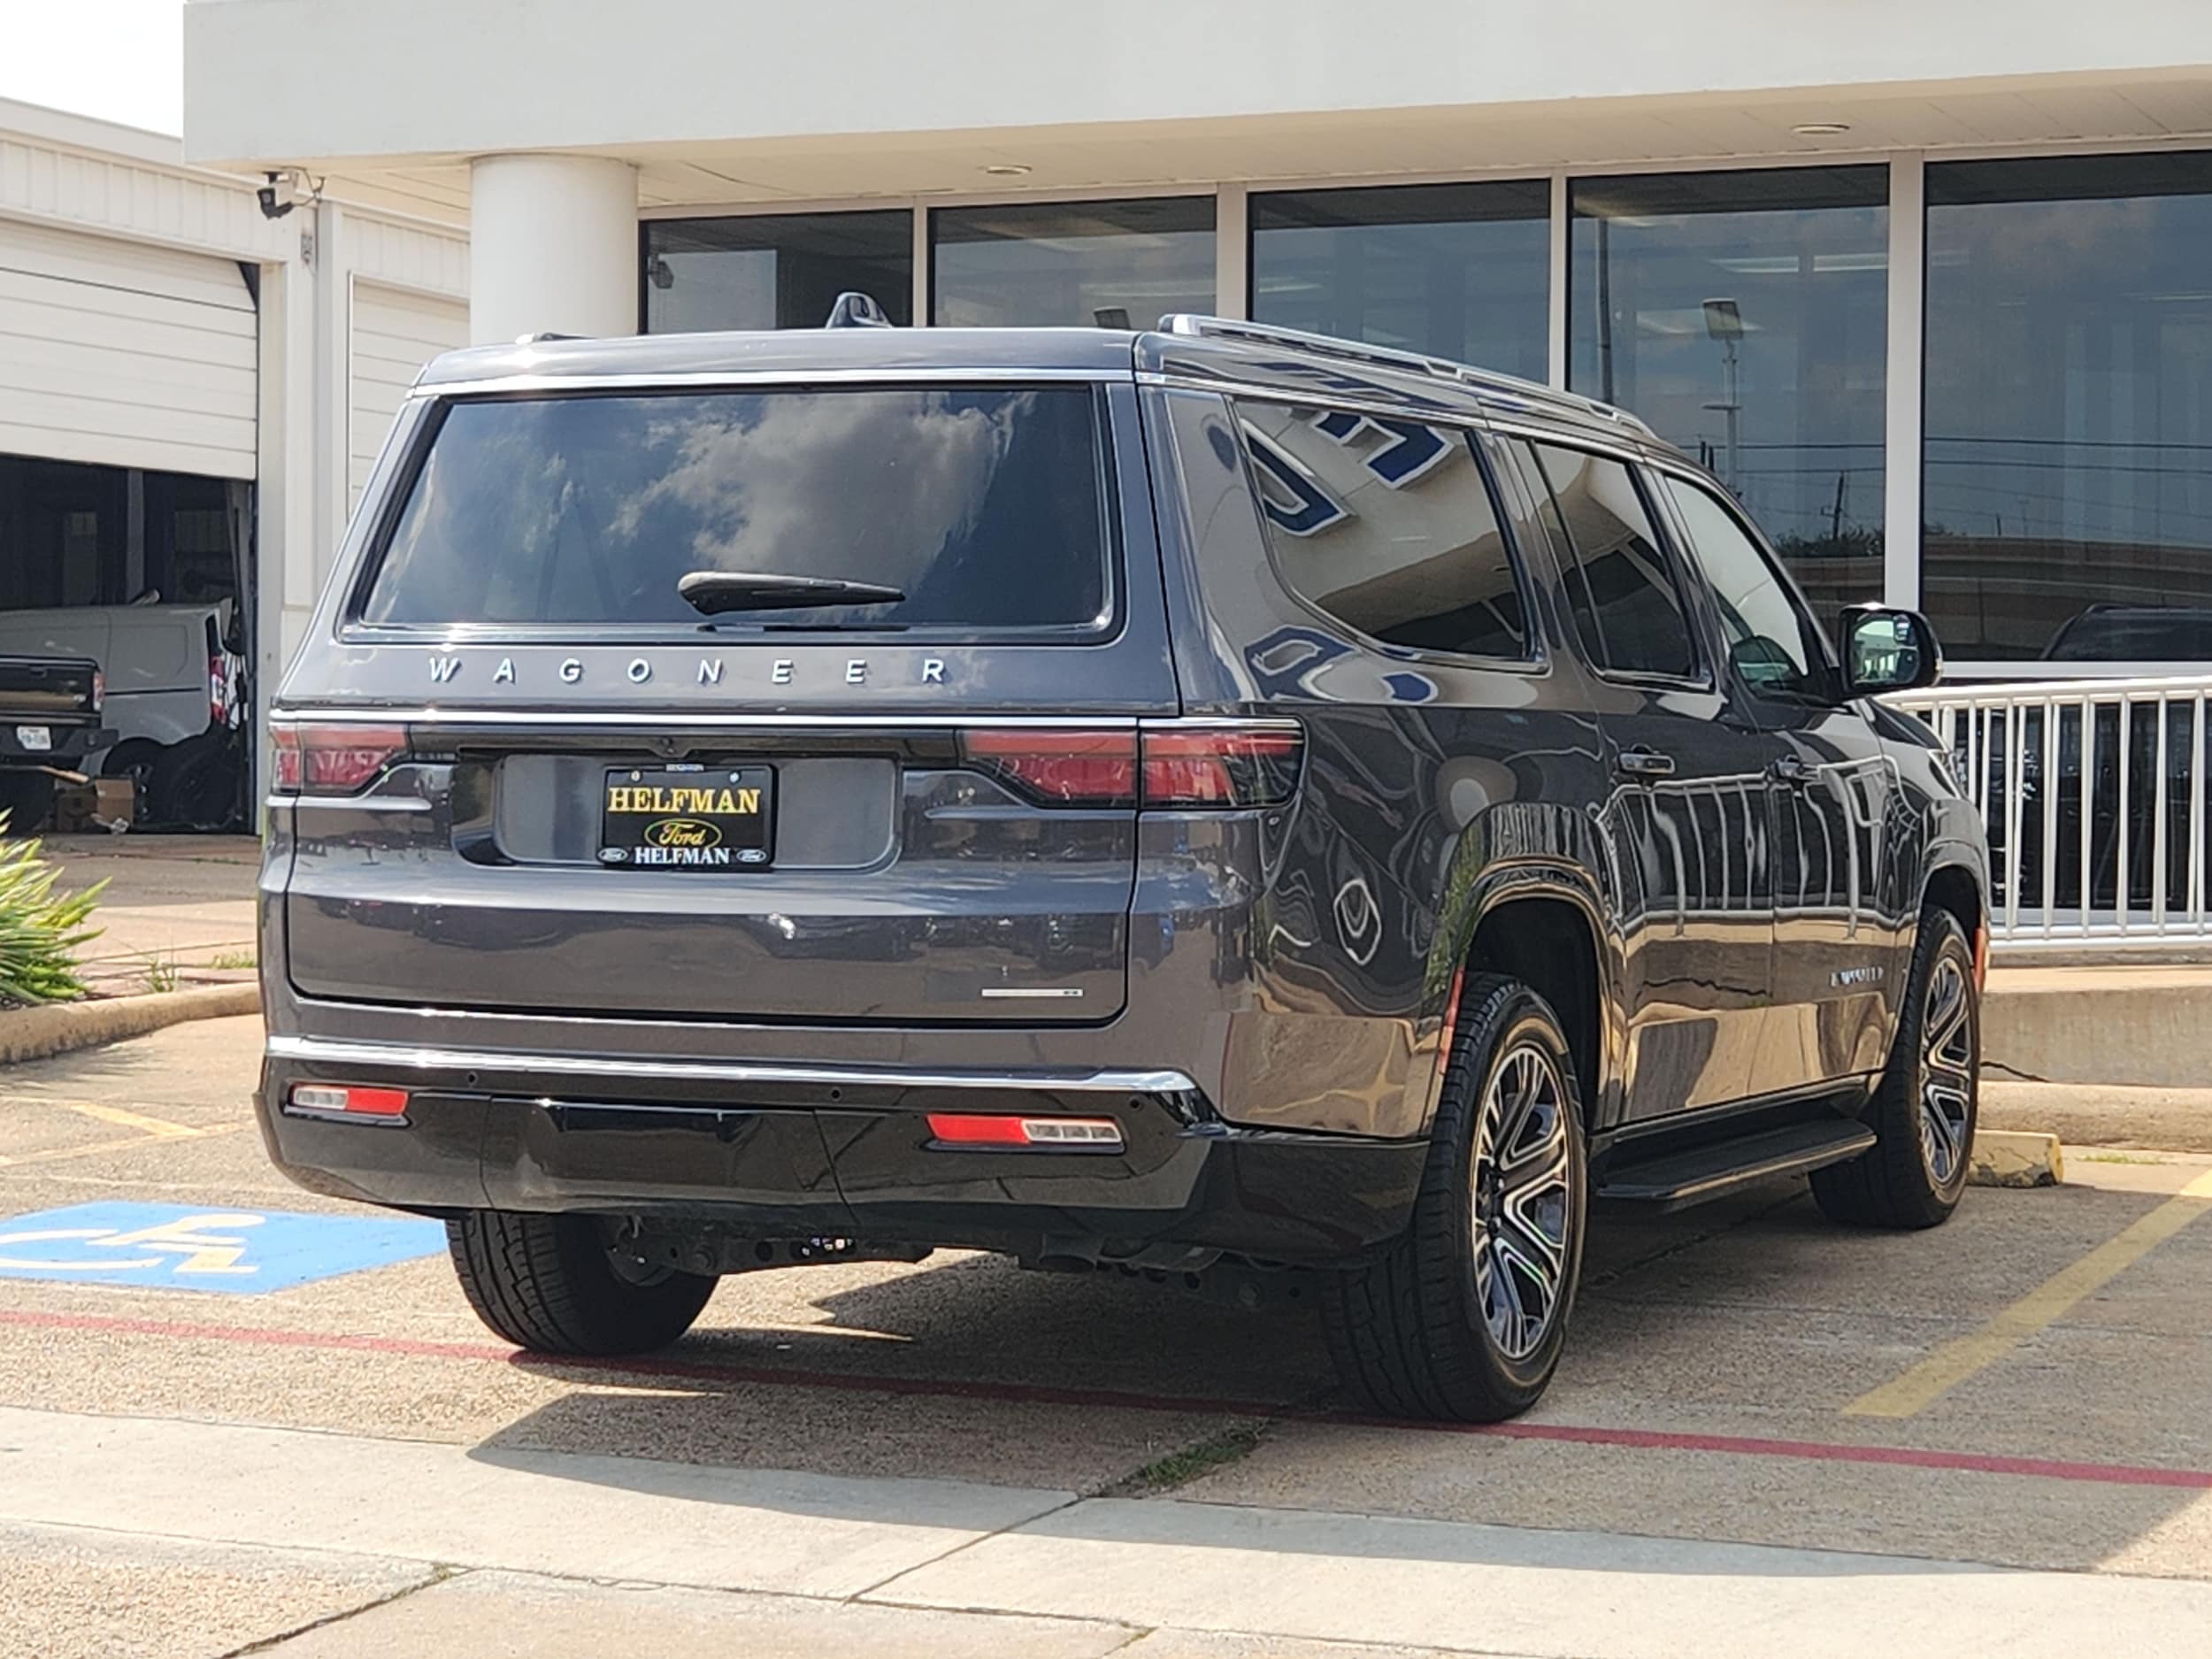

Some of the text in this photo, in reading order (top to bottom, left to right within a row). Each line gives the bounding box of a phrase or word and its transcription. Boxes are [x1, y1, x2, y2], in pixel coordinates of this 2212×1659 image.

[429, 657, 946, 683] WAGONEER
[608, 787, 760, 813] HELFMAN
[658, 823, 705, 845] Ford
[634, 846, 730, 864] HELFMAN
